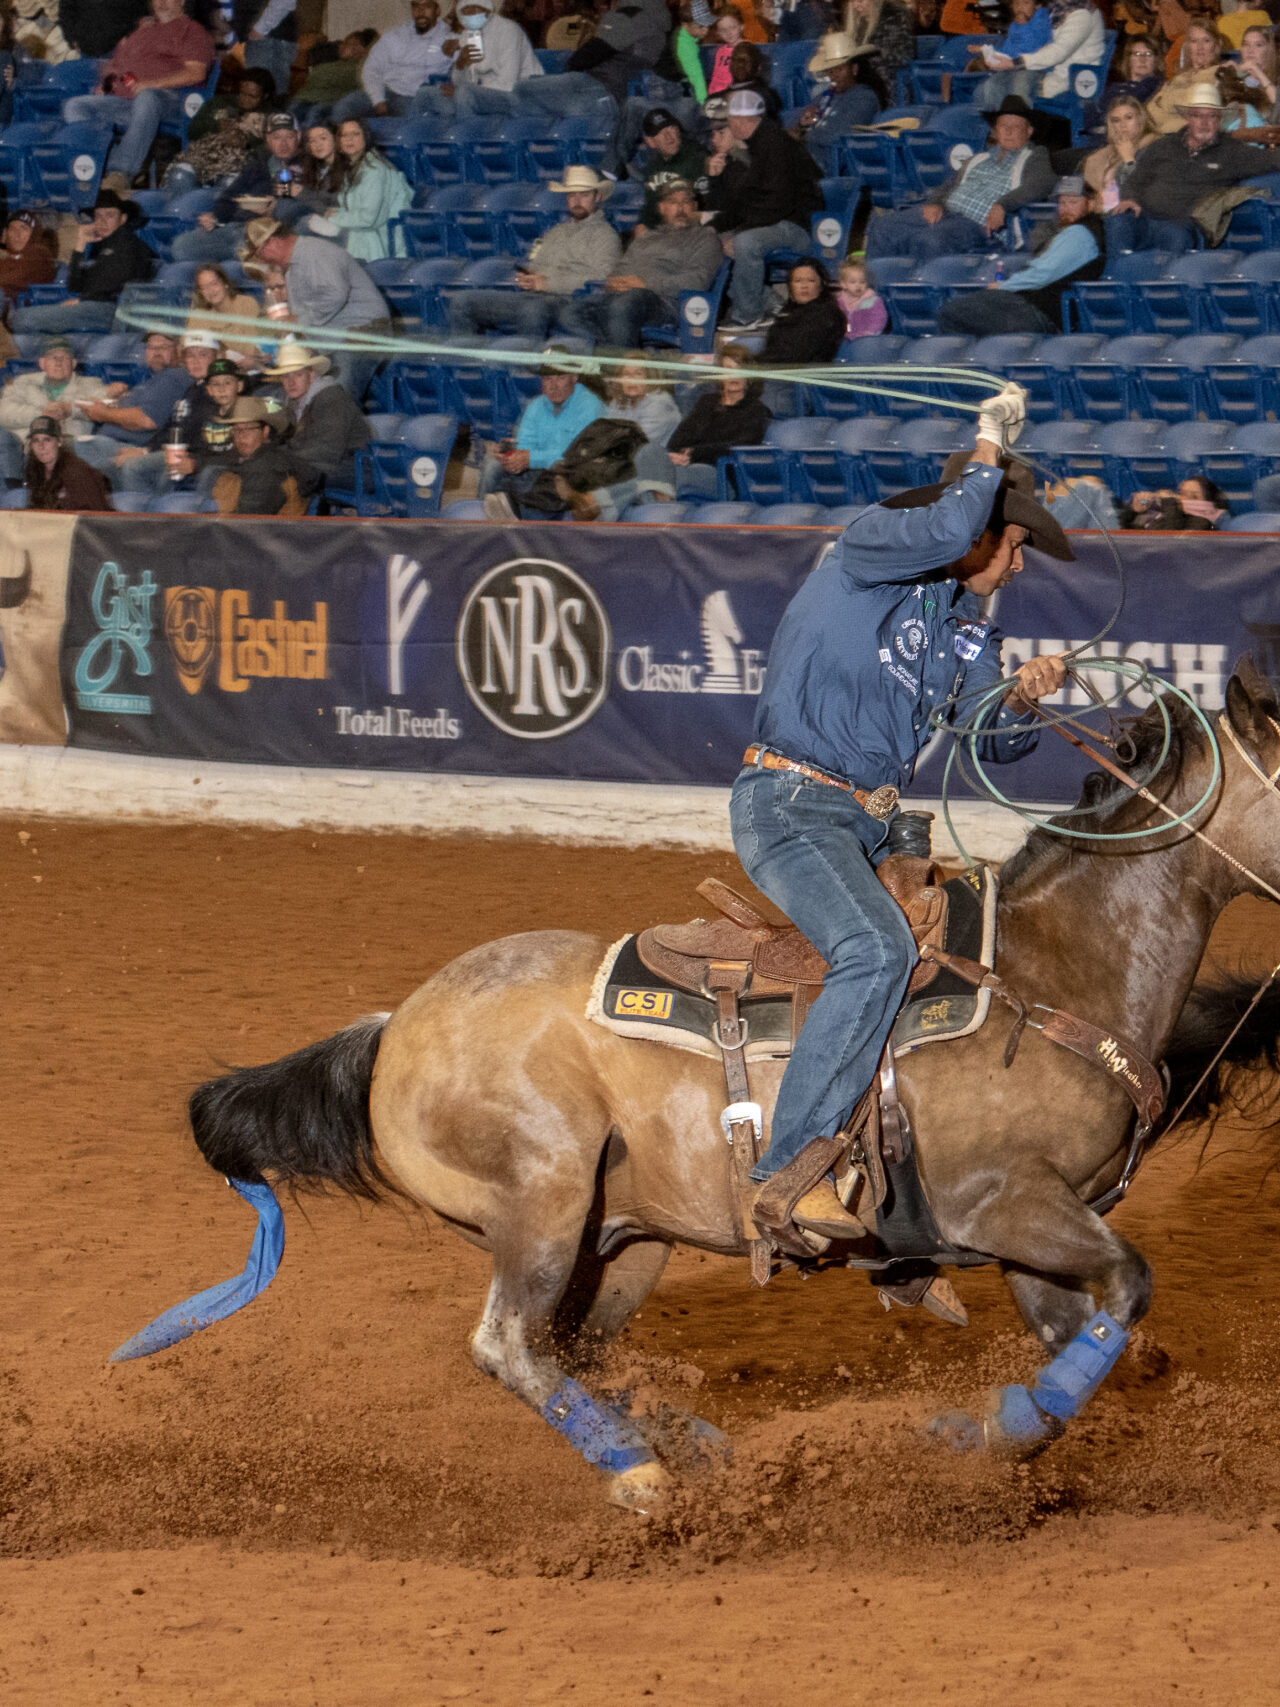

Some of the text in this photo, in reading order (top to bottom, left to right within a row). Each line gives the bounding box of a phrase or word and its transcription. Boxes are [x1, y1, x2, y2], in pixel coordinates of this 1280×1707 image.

[219, 588, 329, 692] Cashel
[480, 575, 589, 717] NRS
[619, 645, 701, 693] Classic
[335, 706, 461, 739] Total Feeds
[620, 991, 669, 1013] CSI
